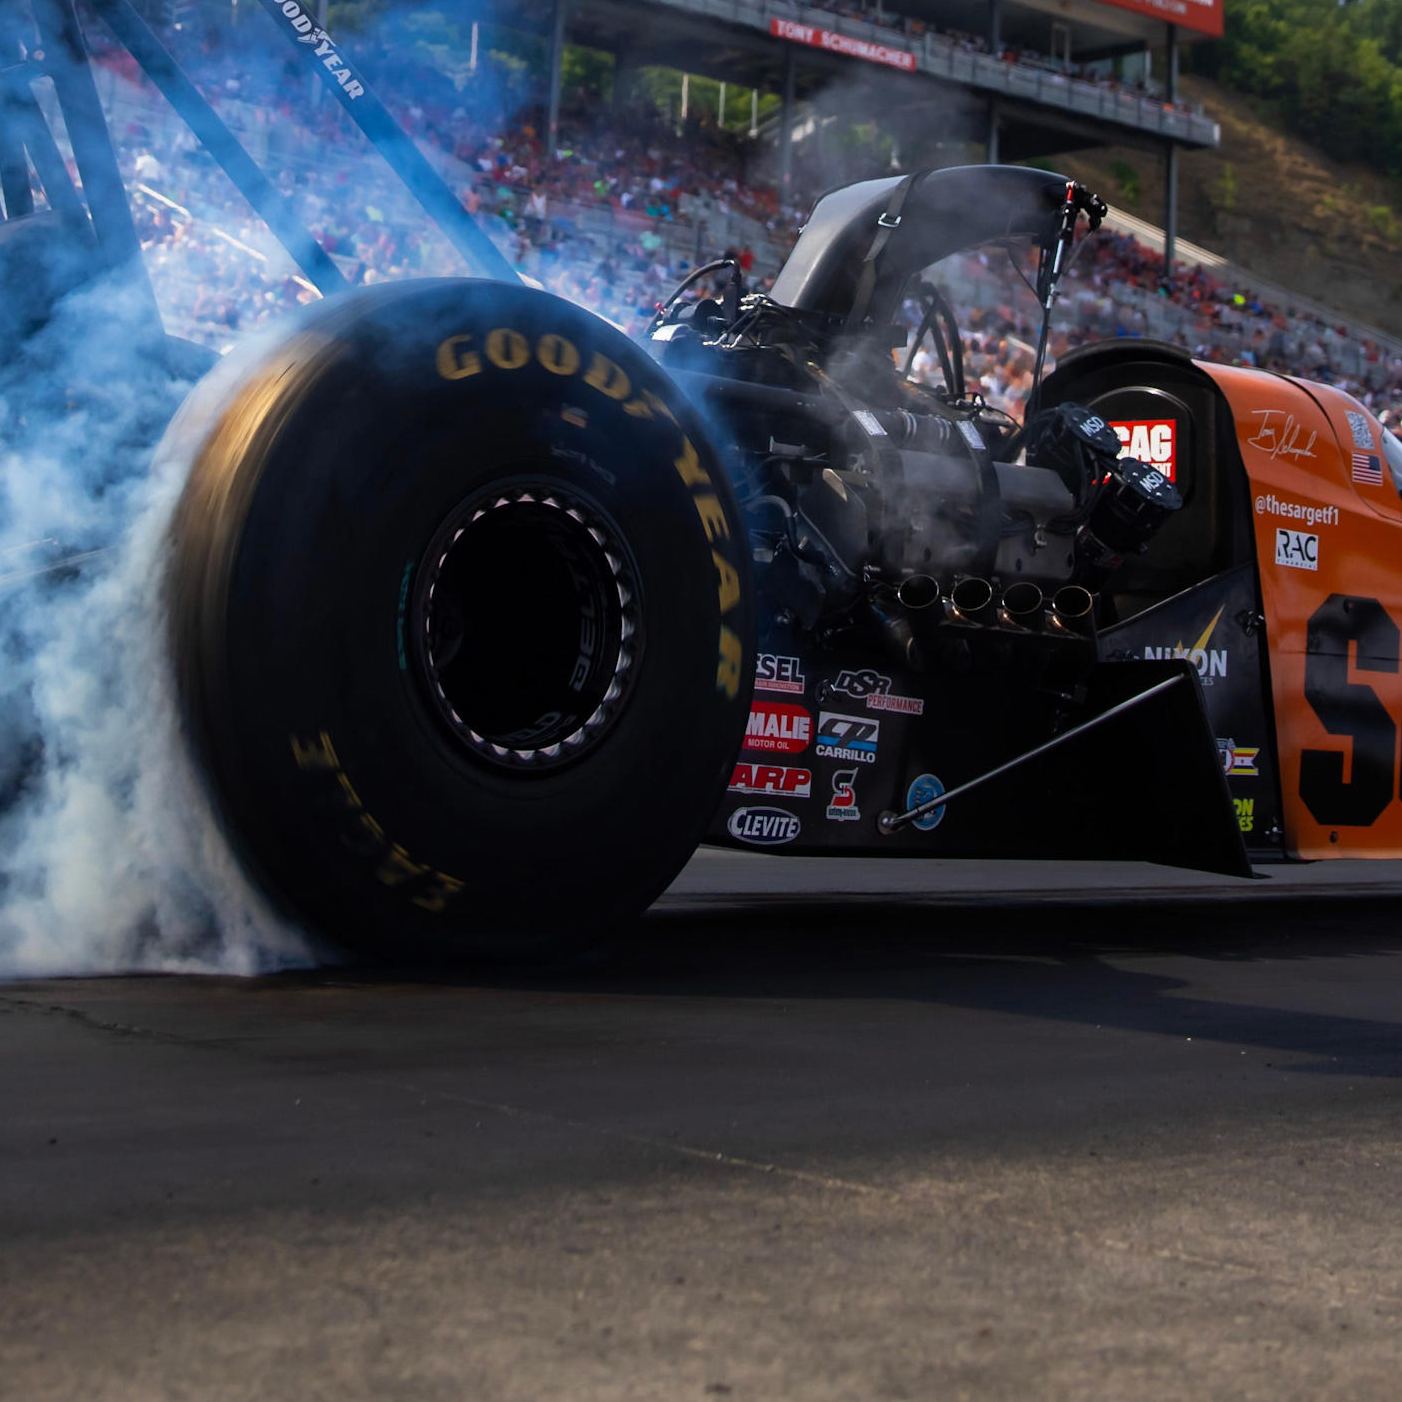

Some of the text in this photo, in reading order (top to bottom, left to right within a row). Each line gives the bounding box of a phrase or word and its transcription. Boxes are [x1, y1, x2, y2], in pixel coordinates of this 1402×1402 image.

[775, 19, 913, 70] TONY SCHUMACHER
[1079, 416, 1105, 437] MSD
[1113, 423, 1173, 463] CAG
[1139, 471, 1165, 493] MSD
[435, 327, 743, 699] GOODYEAR
[1254, 494, 1340, 527] @thesargetf1
[867, 695, 923, 714] PERFORMANCE
[745, 711, 810, 740] MALIE
[747, 738, 790, 750] MOTOR OIL
[815, 744, 876, 764] CARRILLO
[729, 764, 811, 792] ARP
[731, 805, 799, 838] CLEVITE
